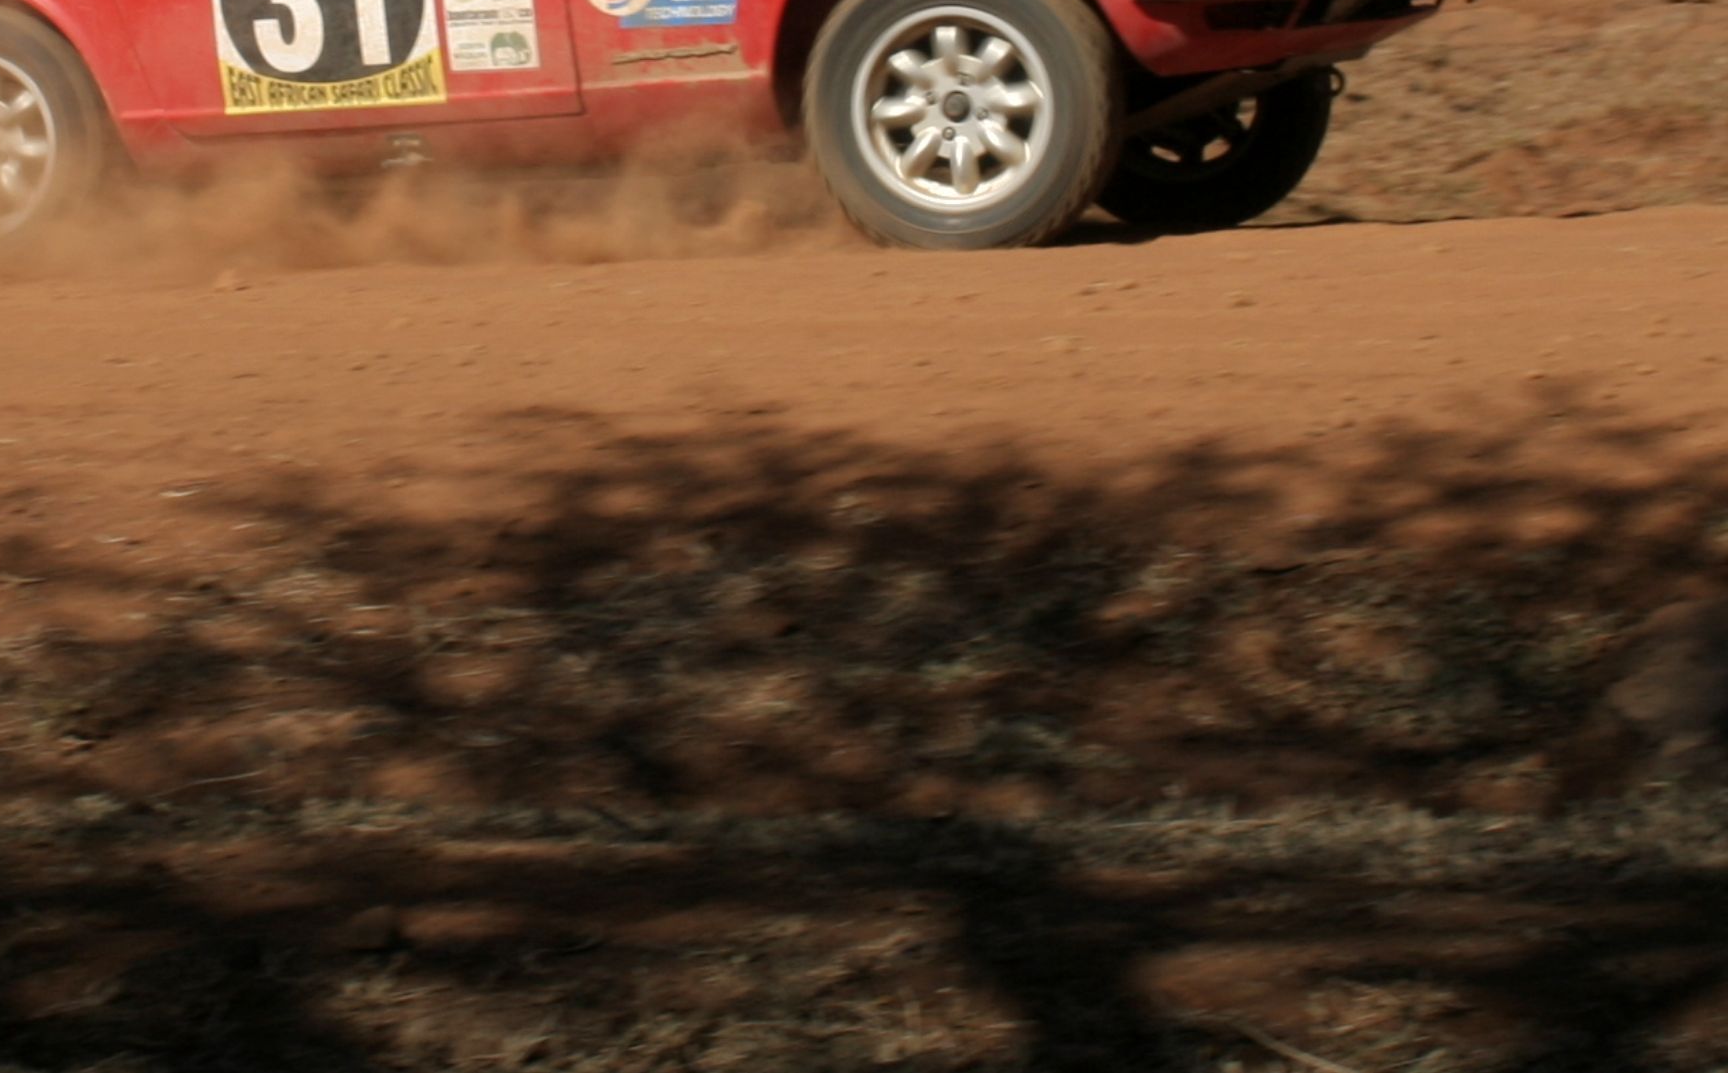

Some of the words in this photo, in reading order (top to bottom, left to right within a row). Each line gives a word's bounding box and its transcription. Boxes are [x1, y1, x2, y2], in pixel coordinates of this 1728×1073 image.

[228, 67, 264, 107] EAST
[268, 81, 326, 107] AFRICAN
[331, 78, 381, 104] SAFARI
[383, 55, 438, 100] CLASSIC
